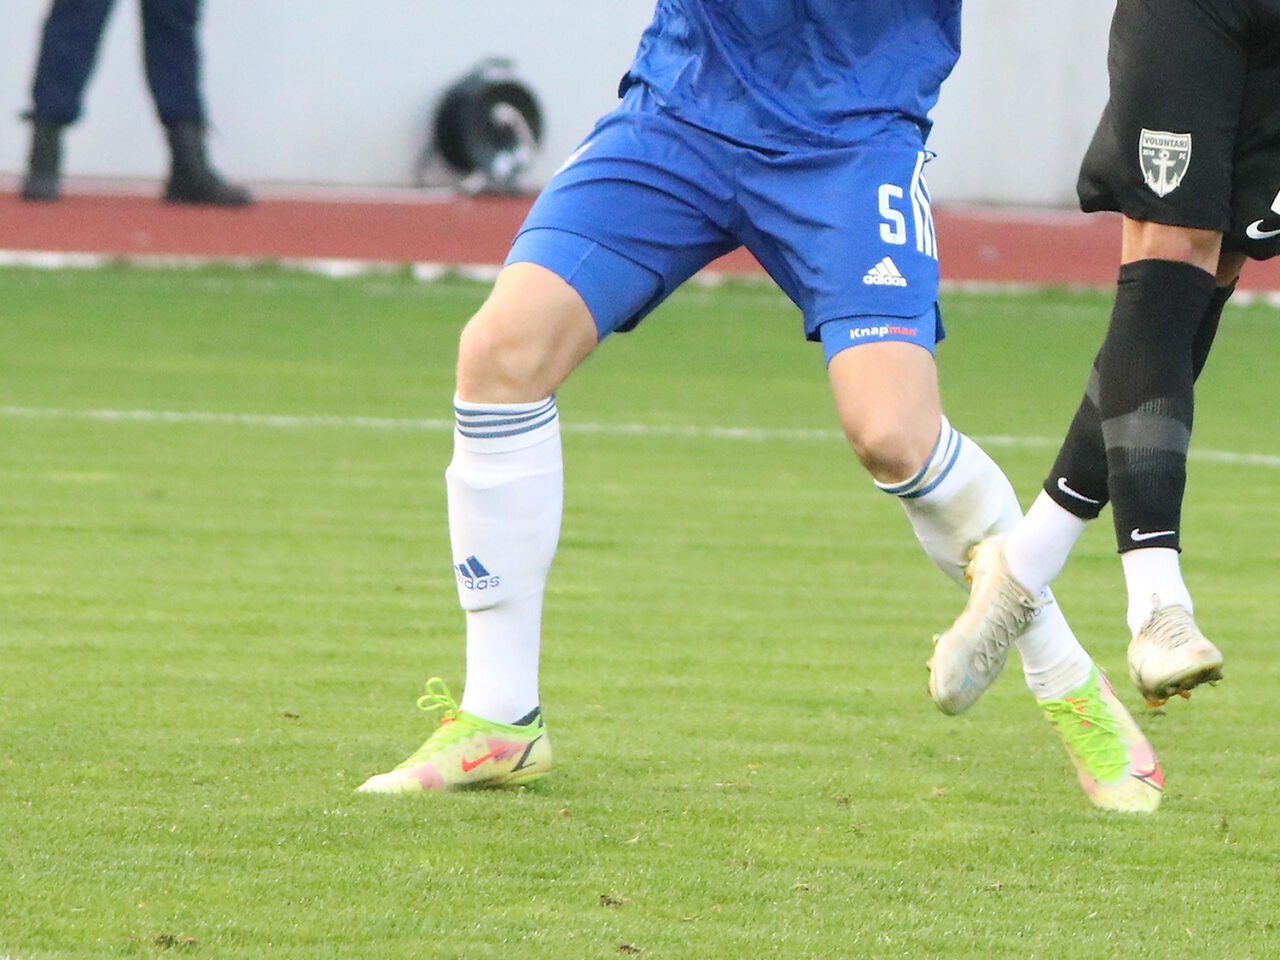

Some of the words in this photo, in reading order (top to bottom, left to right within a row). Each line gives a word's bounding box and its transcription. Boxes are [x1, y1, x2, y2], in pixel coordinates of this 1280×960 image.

[1144, 136, 1188, 149] VOLUNTARI
[878, 183, 907, 245] 5
[862, 273, 908, 288] adidas
